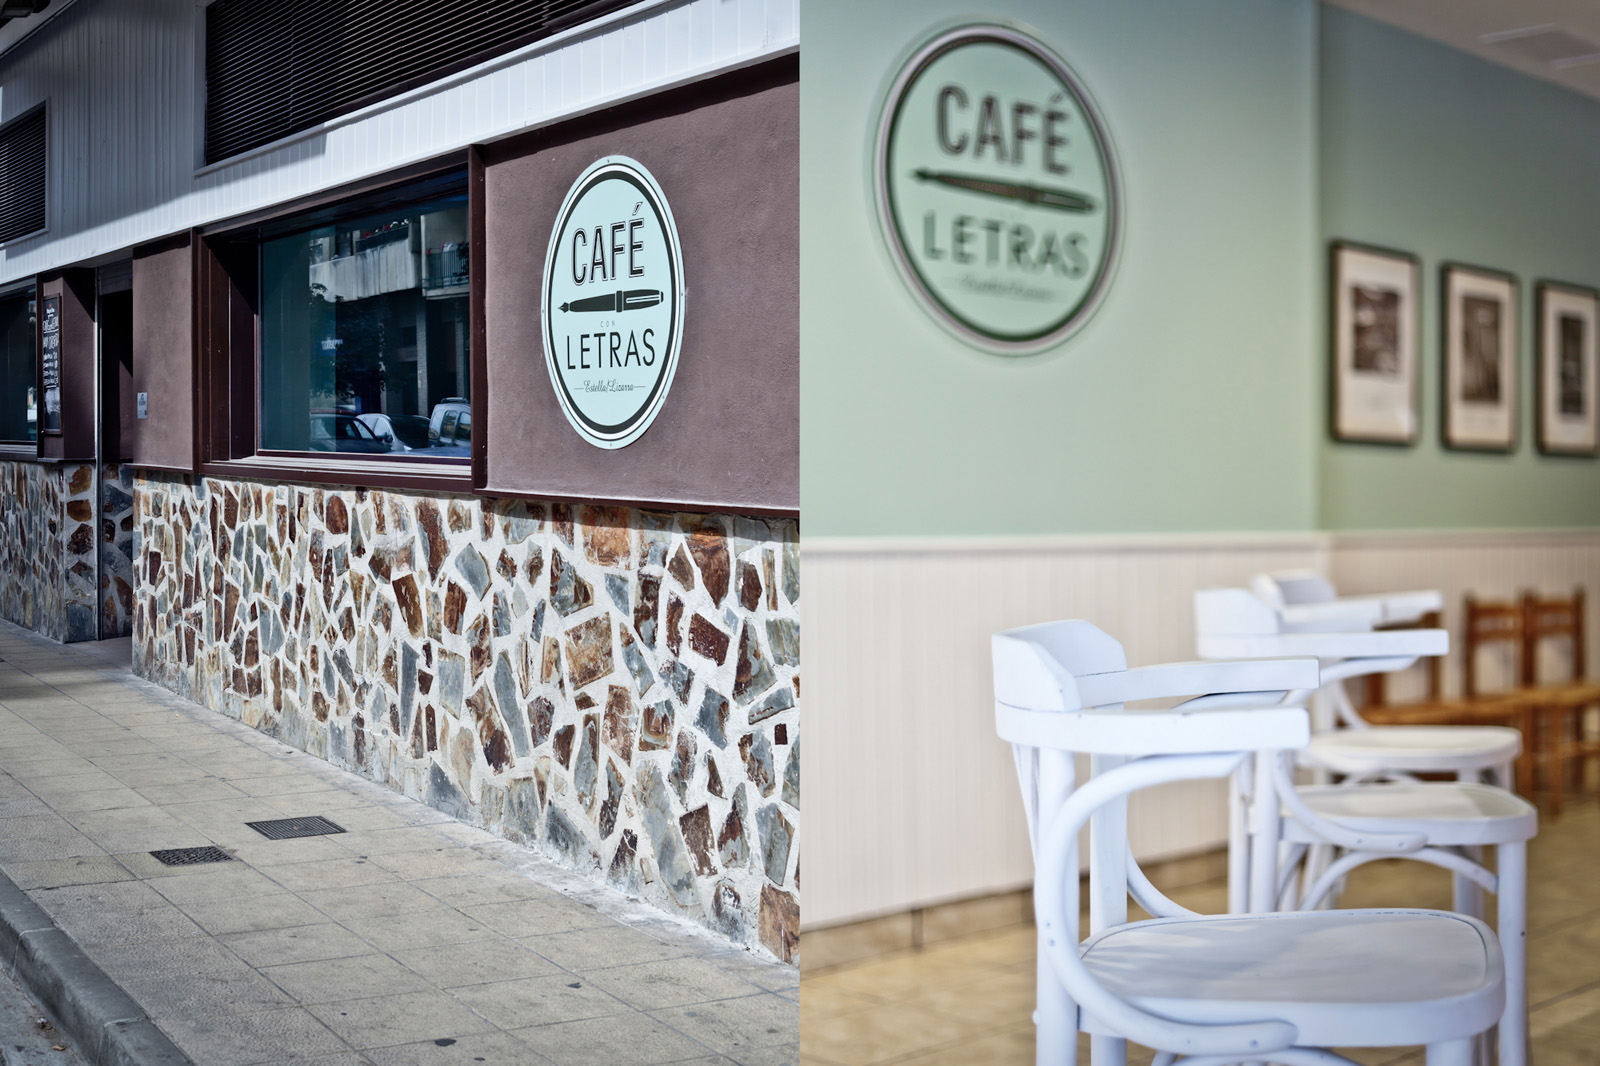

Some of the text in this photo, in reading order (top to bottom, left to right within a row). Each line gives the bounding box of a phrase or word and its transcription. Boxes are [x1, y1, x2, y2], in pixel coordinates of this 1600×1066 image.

[936, 85, 1070, 175] CAFÉ
[571, 201, 645, 286] CAFÉ
[922, 210, 1091, 280] LETRAS
[566, 328, 655, 370] LETRAS
